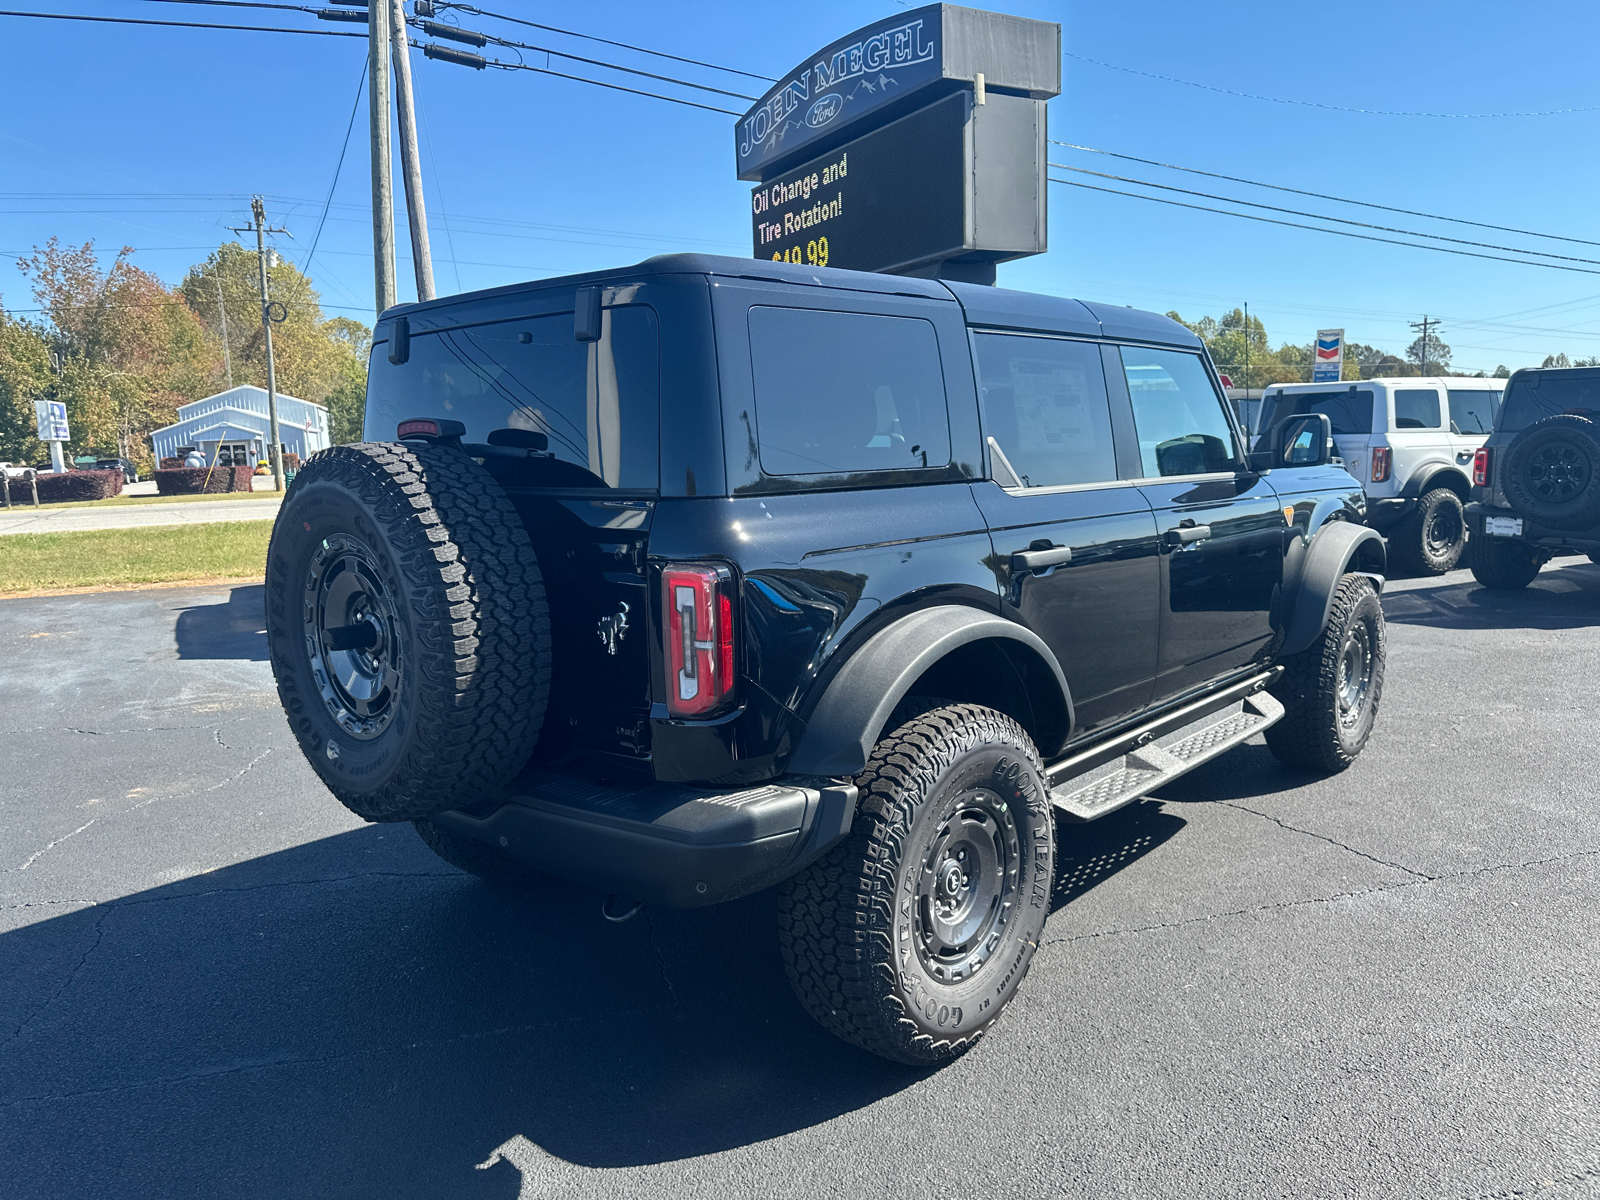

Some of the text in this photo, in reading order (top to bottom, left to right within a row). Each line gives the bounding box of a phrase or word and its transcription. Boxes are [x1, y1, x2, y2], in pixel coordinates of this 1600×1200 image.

[740, 19, 934, 157] JOHN MEGEL
[812, 99, 836, 125] Ford
[753, 152, 848, 215] Oil Change and
[758, 192, 843, 245] Tire Rotation!
[771, 236, 829, 268] 999
[996, 930, 1033, 996] TERRITORY
